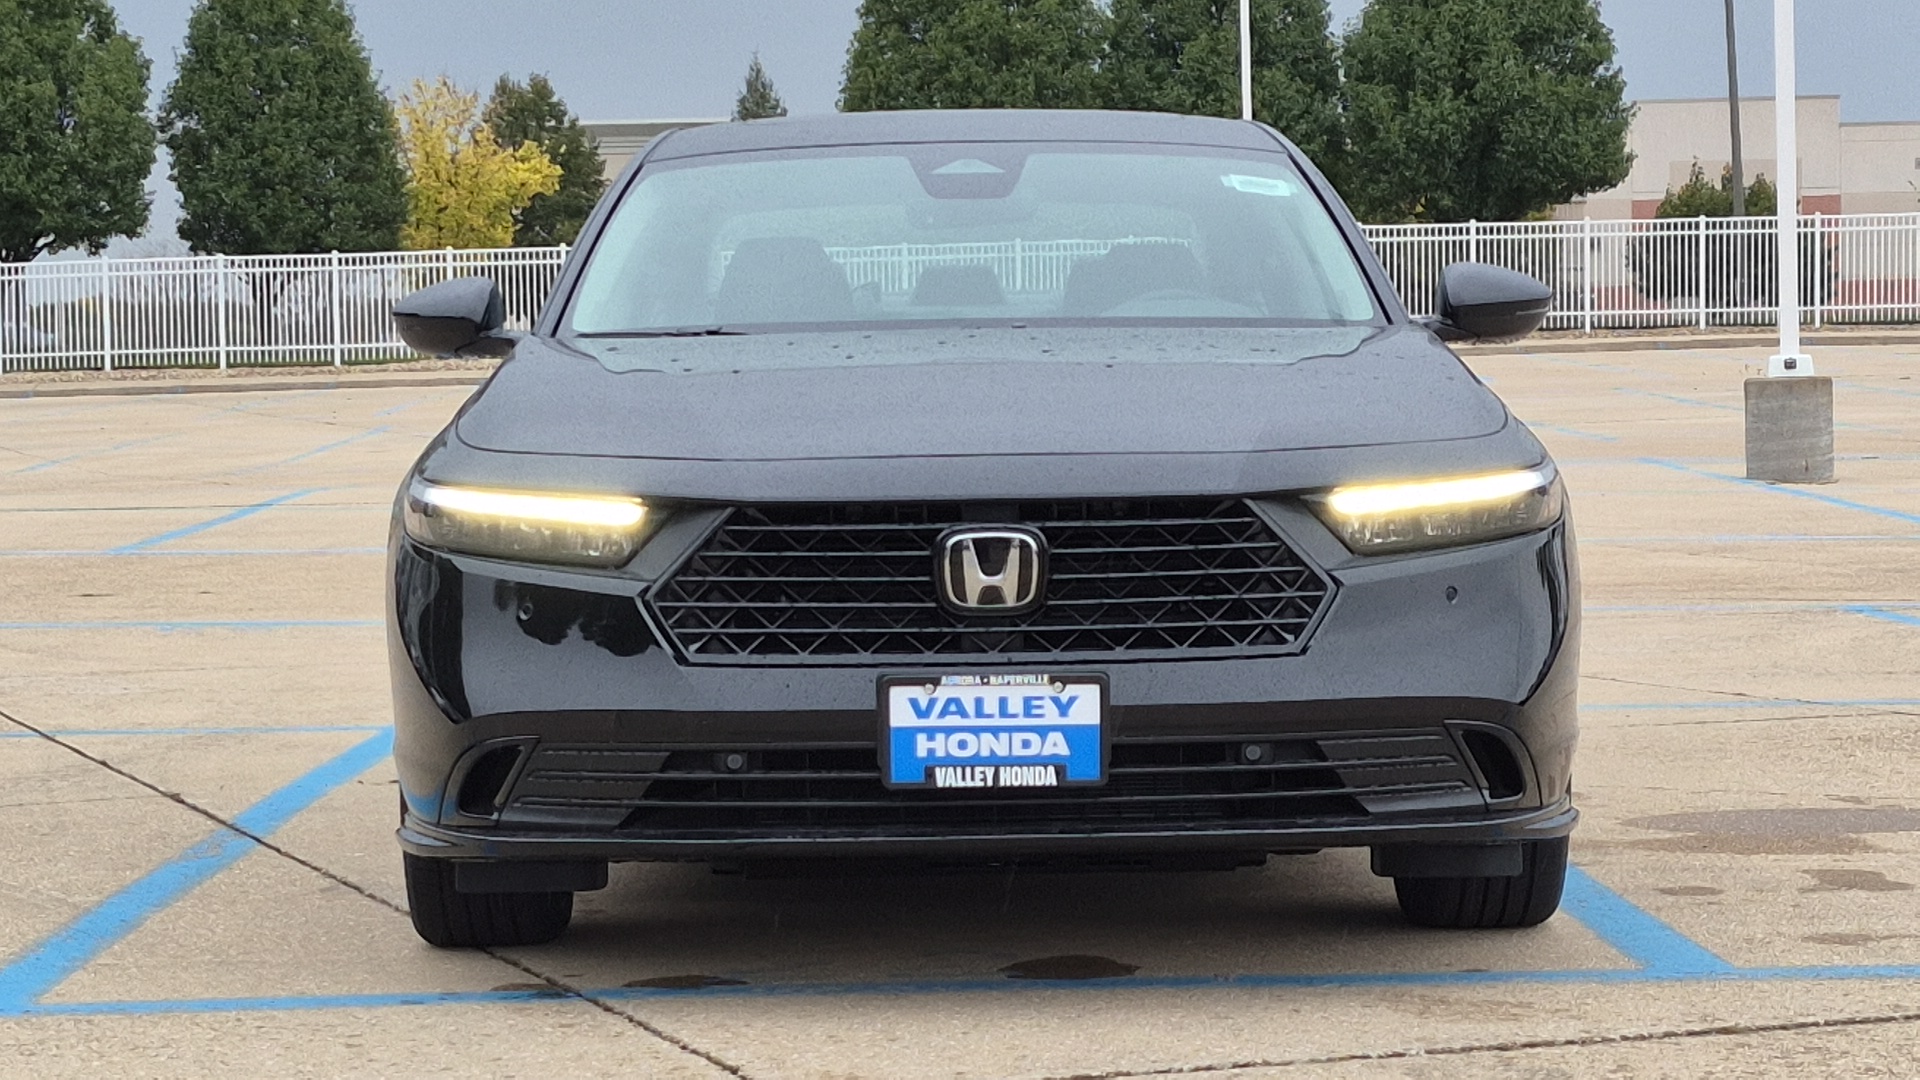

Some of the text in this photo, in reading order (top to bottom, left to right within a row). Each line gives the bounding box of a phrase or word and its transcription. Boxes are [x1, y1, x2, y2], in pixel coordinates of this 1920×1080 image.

[908, 695, 1079, 720] VALLEY
[916, 731, 1071, 757] HONDA
[935, 765, 1057, 787] VALLEY HONDA
